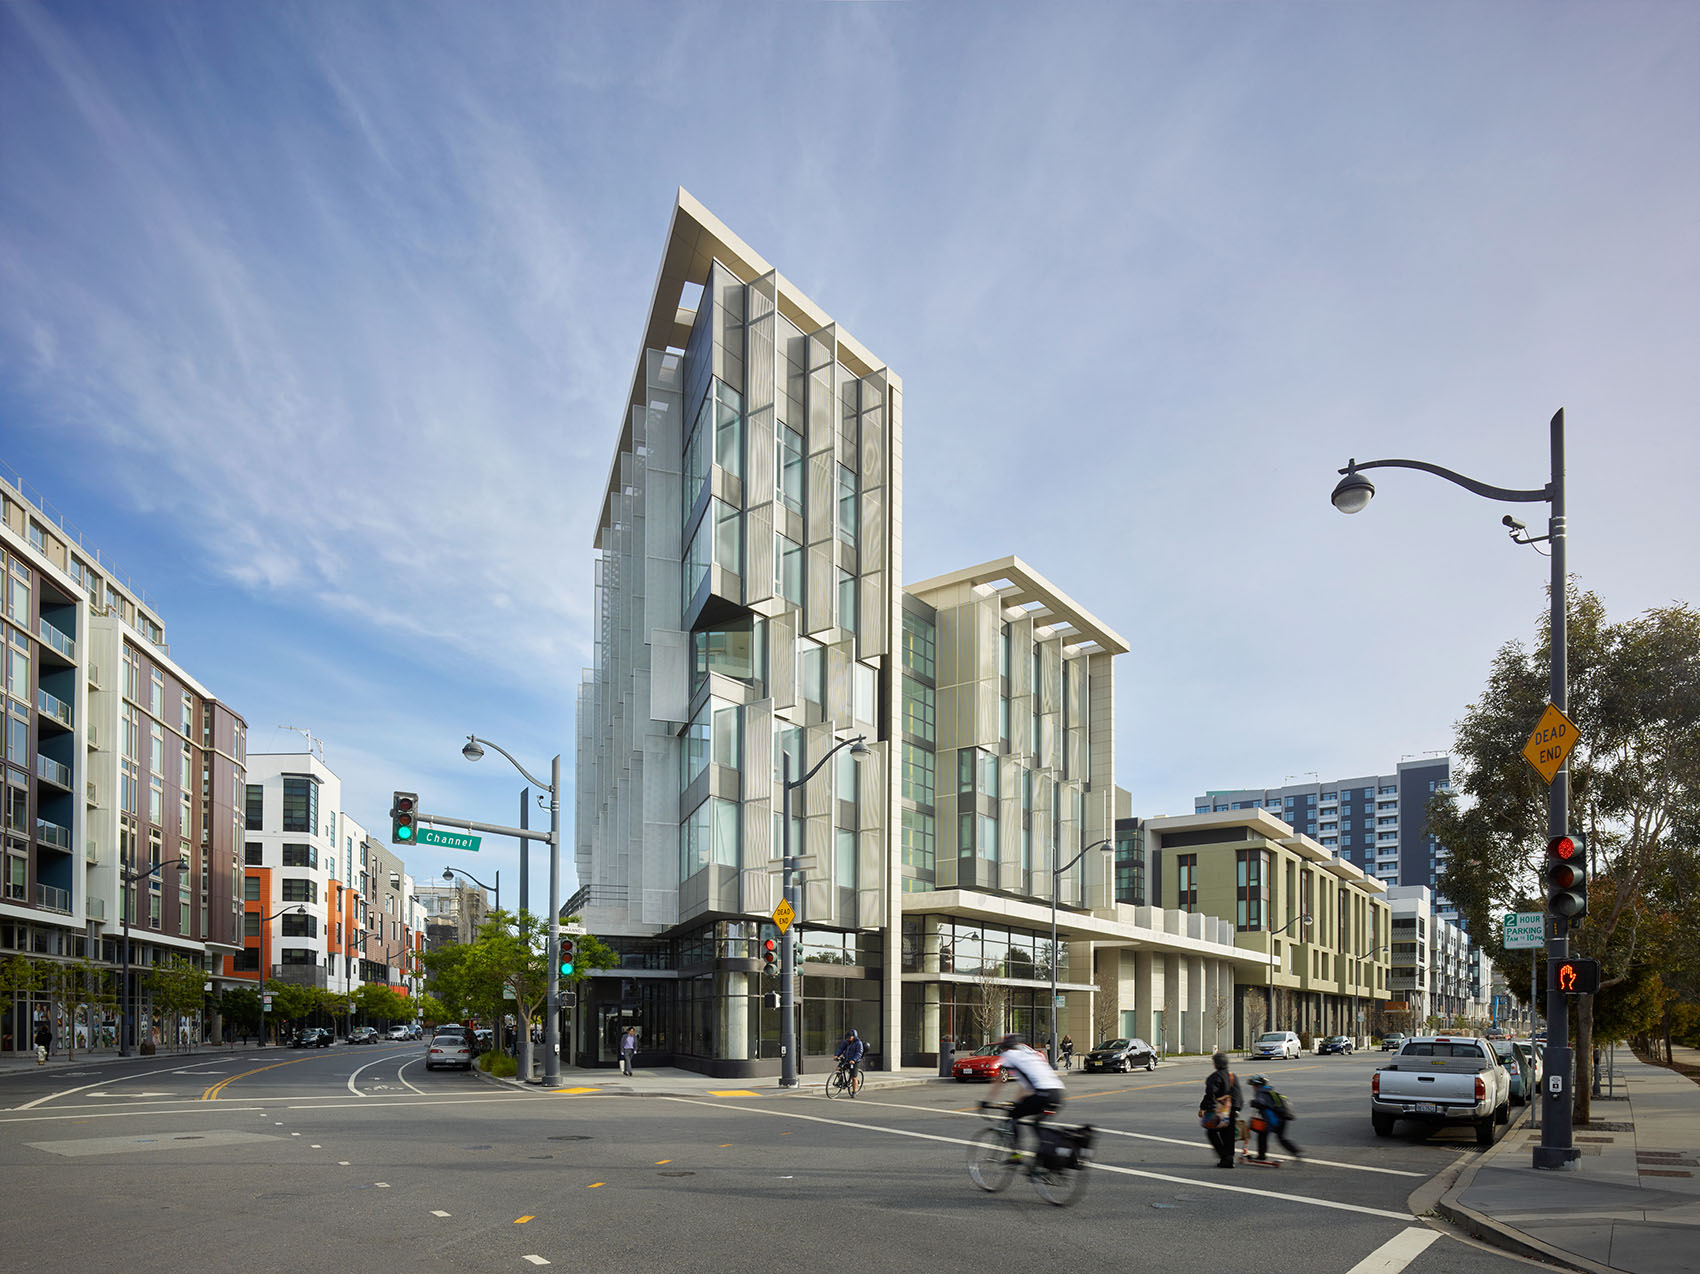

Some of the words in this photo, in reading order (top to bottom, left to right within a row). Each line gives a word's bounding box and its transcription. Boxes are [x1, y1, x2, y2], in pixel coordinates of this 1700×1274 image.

[1535, 723, 1566, 746] DEAD
[1540, 745, 1562, 764] END
[426, 832, 473, 847] Channel
[777, 908, 791, 916] DEAD
[779, 917, 789, 925] END
[1506, 914, 1516, 926] 2
[1519, 915, 1541, 924] HOUR
[1506, 926, 1542, 935] PARKING
